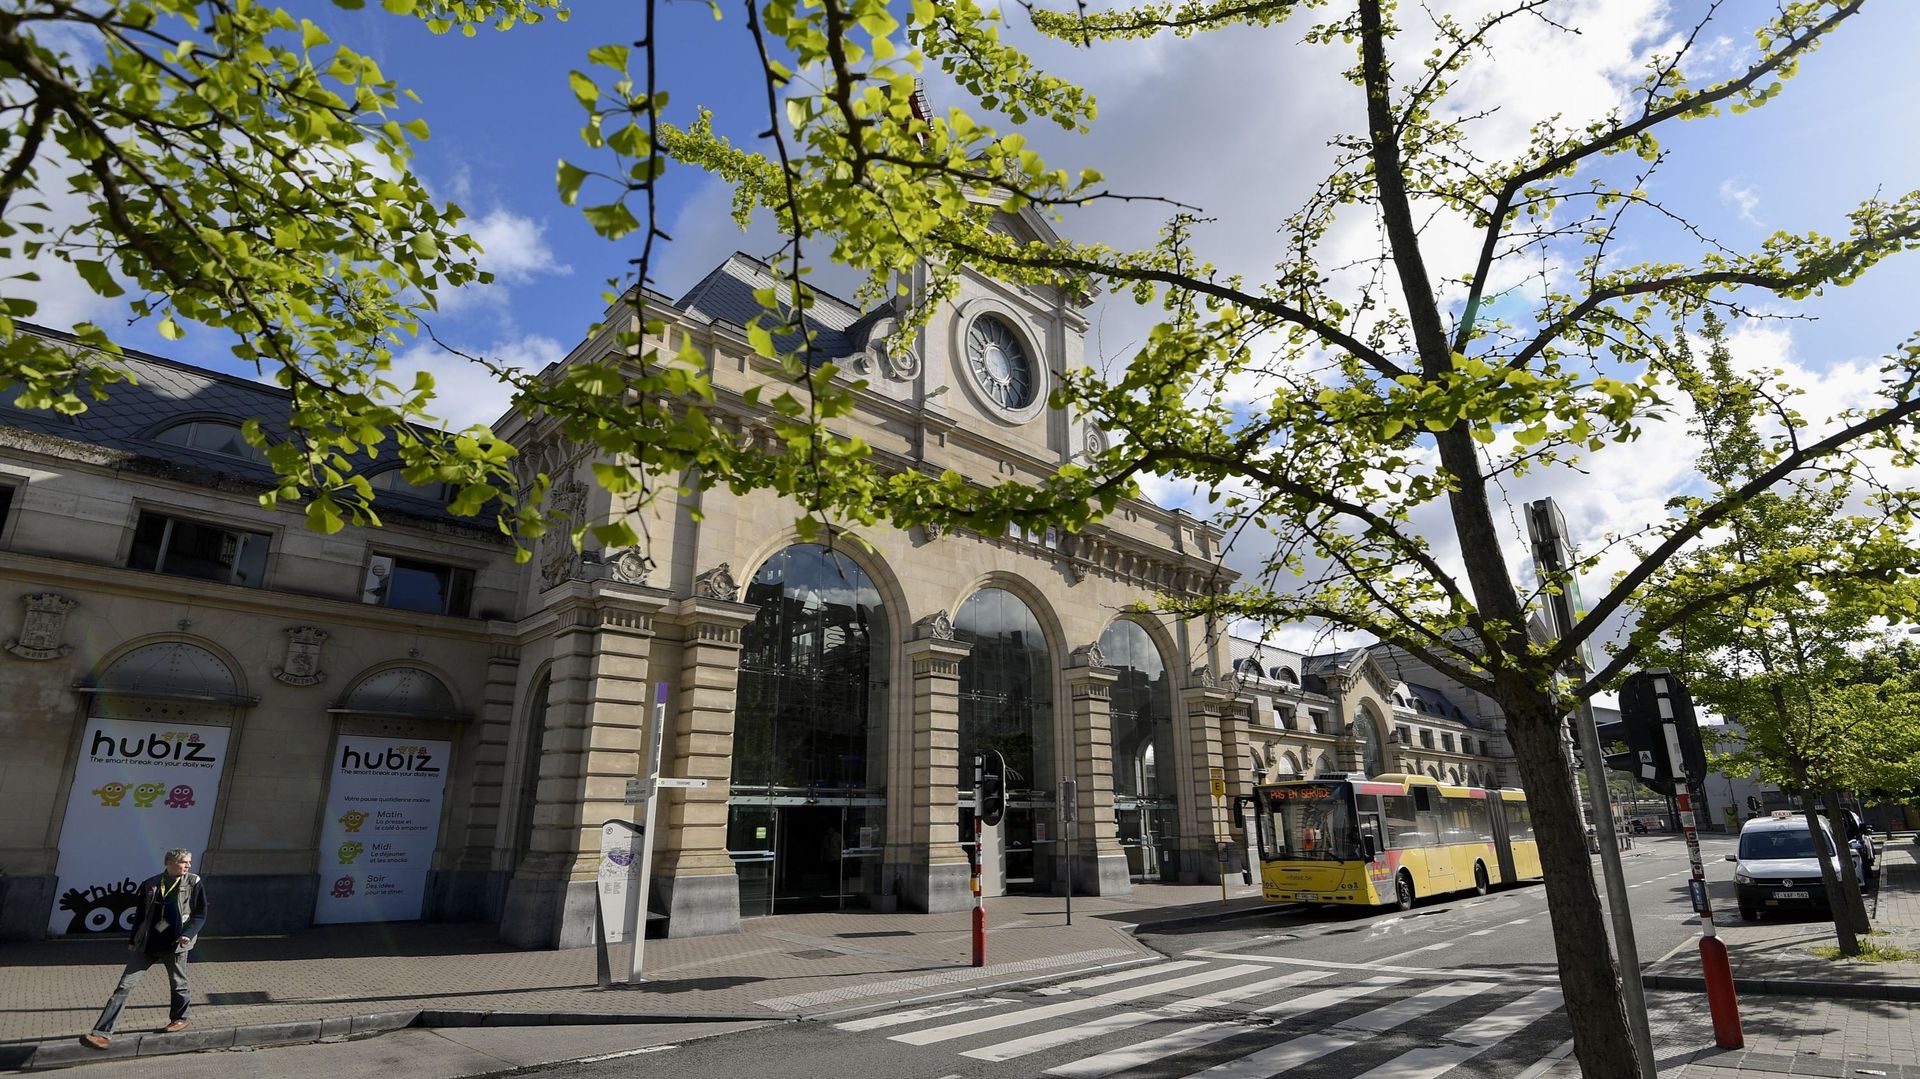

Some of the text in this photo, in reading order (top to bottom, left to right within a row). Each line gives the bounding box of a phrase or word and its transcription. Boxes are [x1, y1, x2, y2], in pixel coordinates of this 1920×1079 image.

[91, 730, 215, 762] hubiz
[341, 745, 440, 772] hubiz
[182, 761, 199, 769] daily
[1270, 790, 1284, 800] PAS
[1288, 790, 1297, 799] EN
[377, 810, 403, 818] Matin
[373, 843, 392, 851] Midi
[367, 874, 386, 883] Soir
